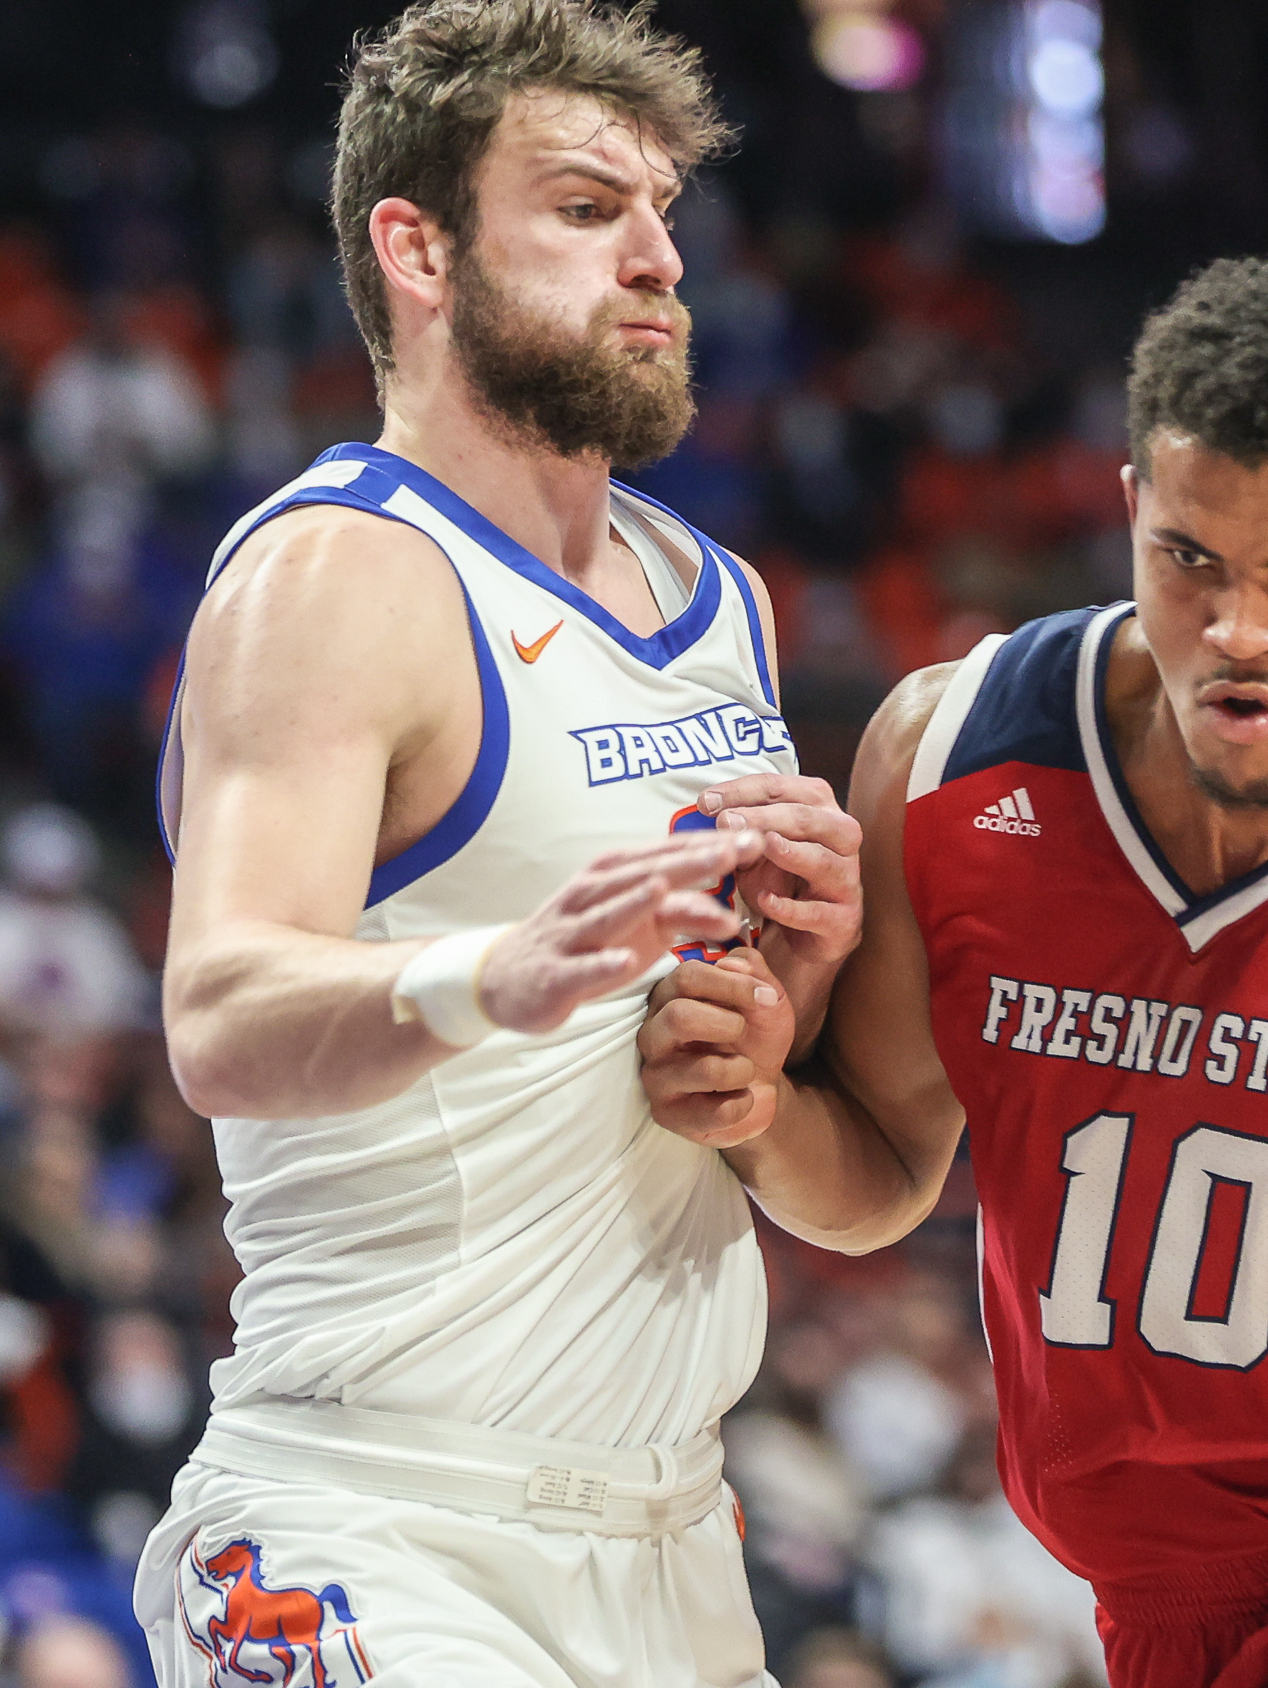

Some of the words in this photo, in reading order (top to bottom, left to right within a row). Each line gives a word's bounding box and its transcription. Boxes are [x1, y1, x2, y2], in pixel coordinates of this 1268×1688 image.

[567, 702, 794, 787] BRONC
[973, 815, 1042, 837] adidas
[981, 975, 1202, 1078] FRESNO
